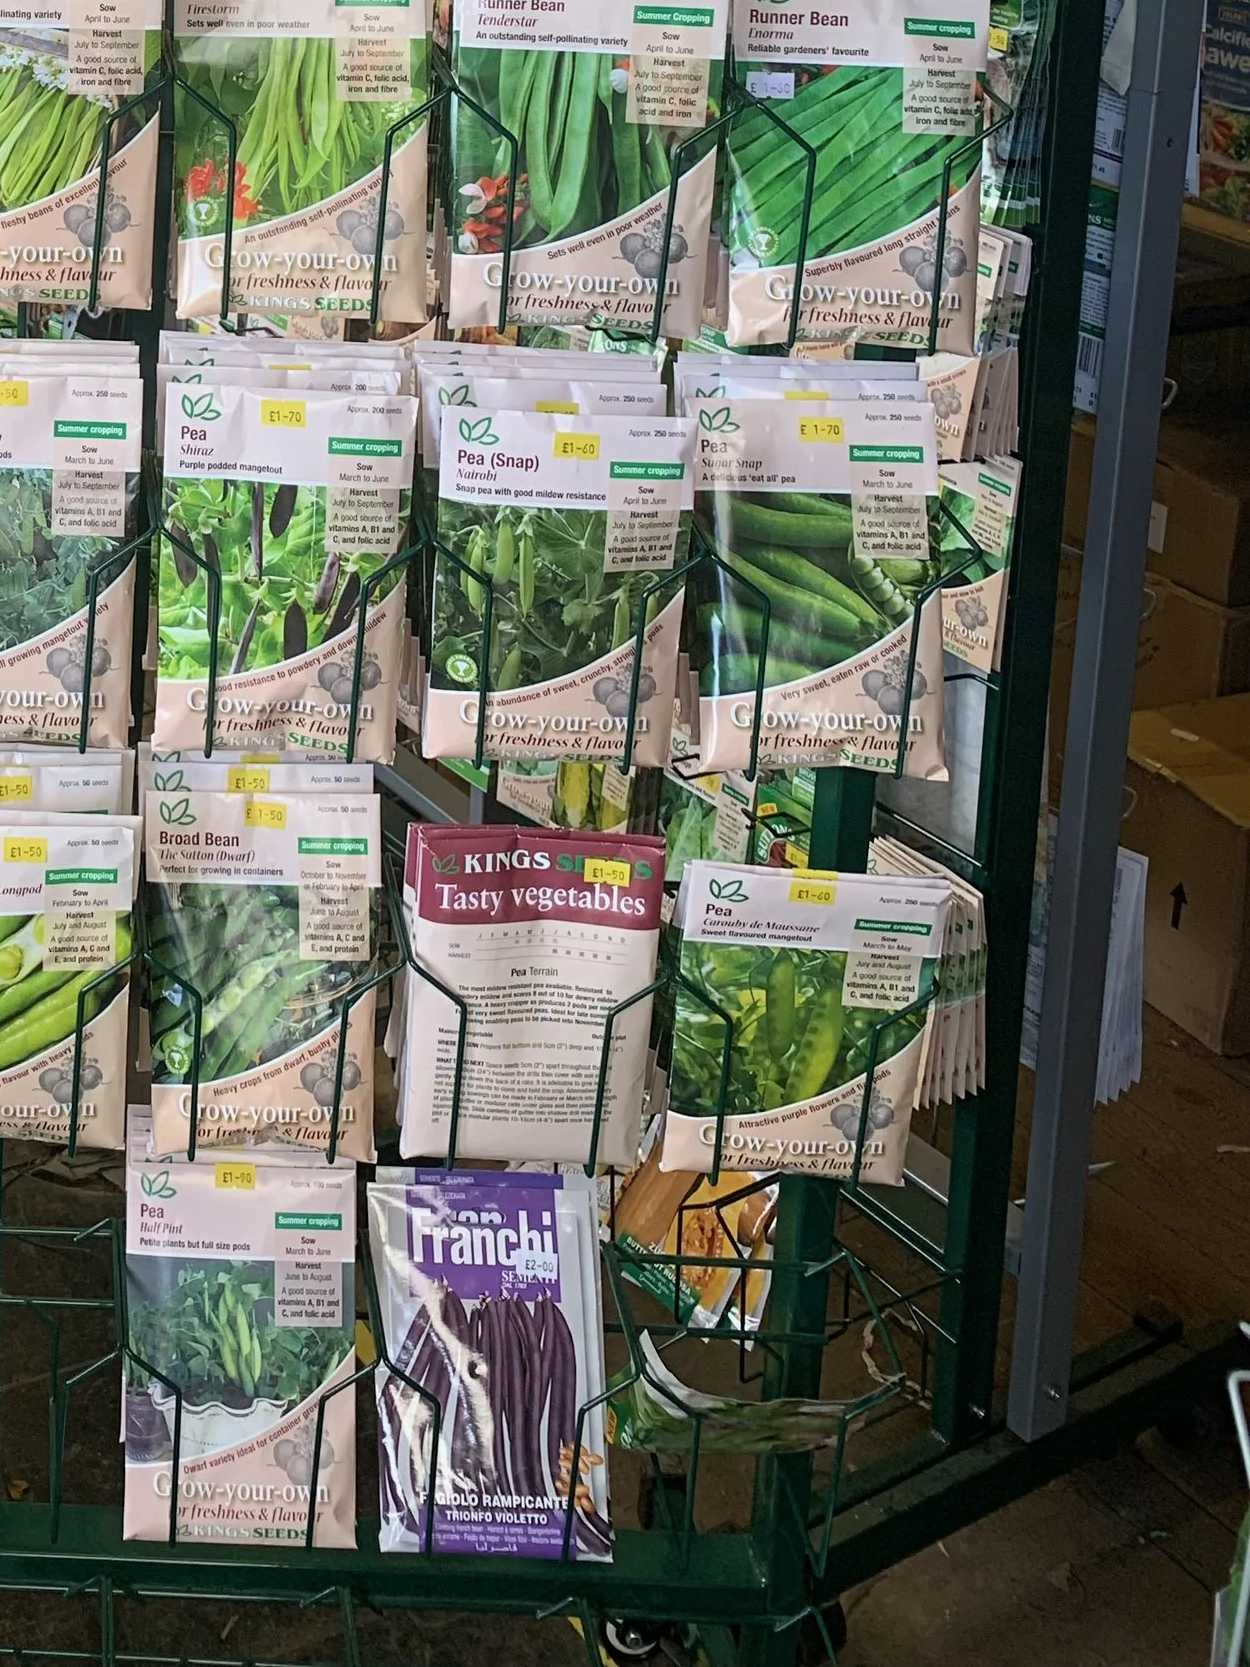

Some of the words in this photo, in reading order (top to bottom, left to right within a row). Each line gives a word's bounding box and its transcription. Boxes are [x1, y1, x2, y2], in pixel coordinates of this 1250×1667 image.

[187, 2, 239, 16] Firestorm
[477, 13, 539, 27] Tenderstar
[748, 27, 793, 39] Enorma
[269, 411, 301, 423] £1-70
[181, 425, 207, 441] Pea
[180, 444, 214, 457] Shiraz
[562, 442, 594, 455] £1-60
[701, 439, 727, 453] Pea
[457, 449, 484, 466] Pea
[490, 453, 539, 472] (Snap)
[702, 457, 731, 470] Sugar
[735, 457, 762, 470] Snap
[456, 469, 497, 482] Nairobi
[160, 831, 200, 847] Broad
[205, 832, 239, 847] Bean
[10, 846, 41, 859] £1-50
[160, 848, 178, 860] The
[181, 849, 211, 861] Sutton
[214, 849, 255, 862] (Dwarf)
[464, 850, 550, 874] KINGS
[592, 868, 624, 881] £1-50
[435, 883, 502, 916] Tasty
[798, 889, 830, 900] £1-60
[706, 904, 732, 917] Pea
[703, 918, 748, 931] Carouby
[750, 919, 765, 929] de
[767, 921, 820, 932] Maussane
[222, 1171, 252, 1183] £1-90
[140, 1203, 164, 1218] Pea
[140, 1221, 159, 1235] Half
[163, 1222, 182, 1234] Pint
[482, 1494, 568, 1509] RAMPICANTE
[445, 1510, 492, 1522] TRIONFO
[495, 1513, 548, 1525] VIOLETTO
